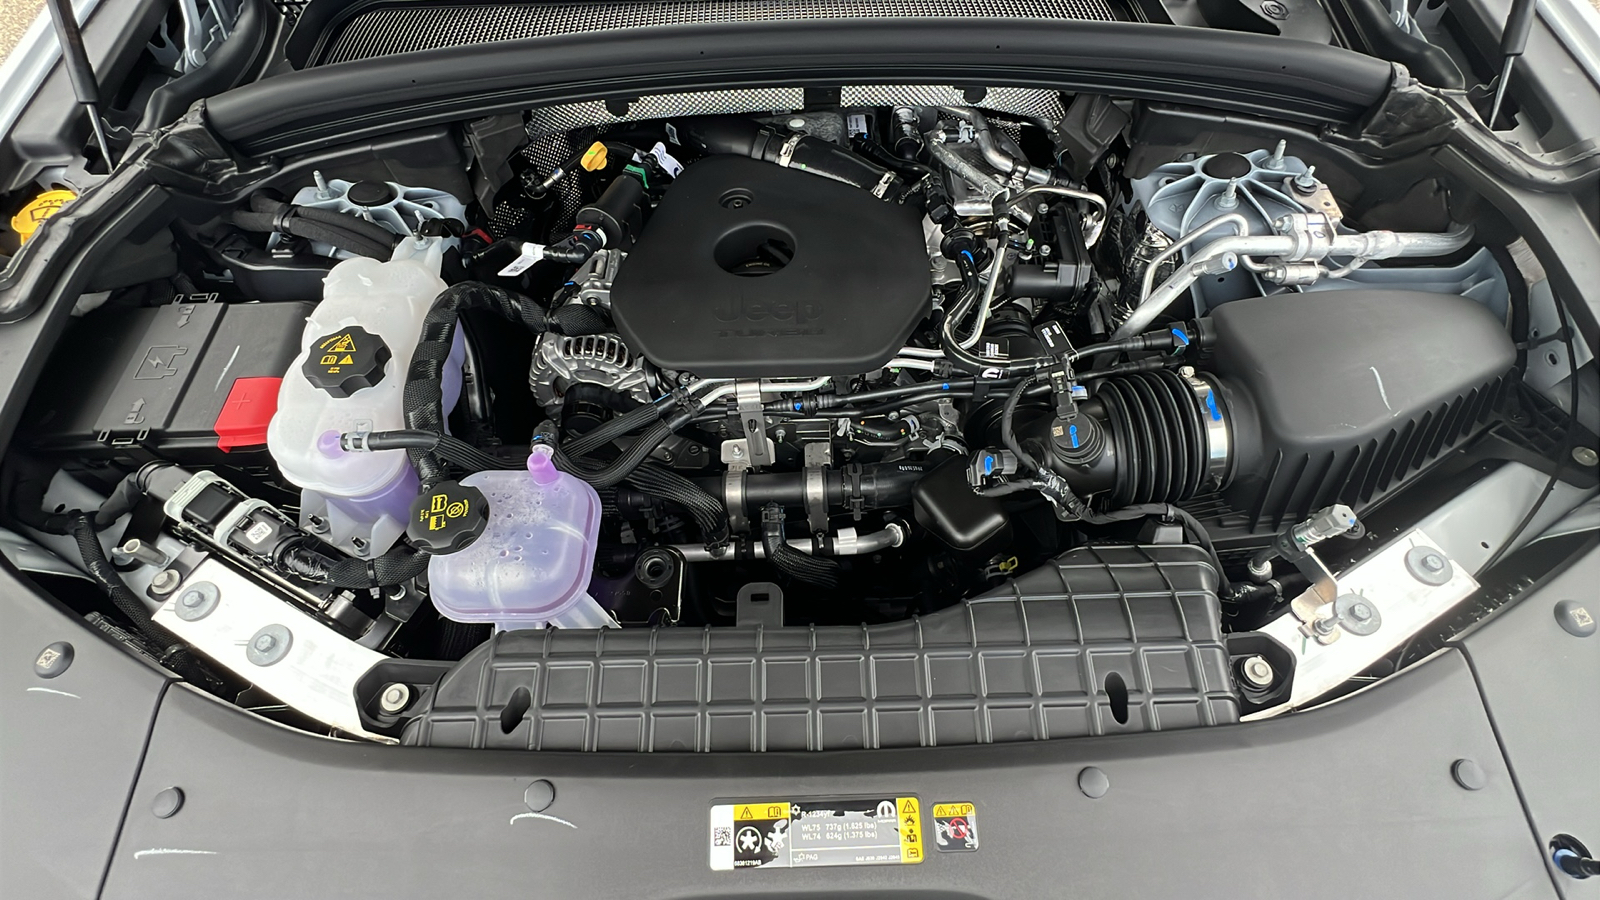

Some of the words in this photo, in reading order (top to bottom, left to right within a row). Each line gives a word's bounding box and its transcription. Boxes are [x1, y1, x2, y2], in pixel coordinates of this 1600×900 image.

[713, 293, 823, 325] Jeep
[801, 824, 821, 832] WL75
[826, 823, 842, 832] 737g
[864, 821, 877, 831] lbs)
[801, 832, 821, 841] WL74
[864, 830, 877, 839] lbs)
[805, 853, 819, 861] PAG
